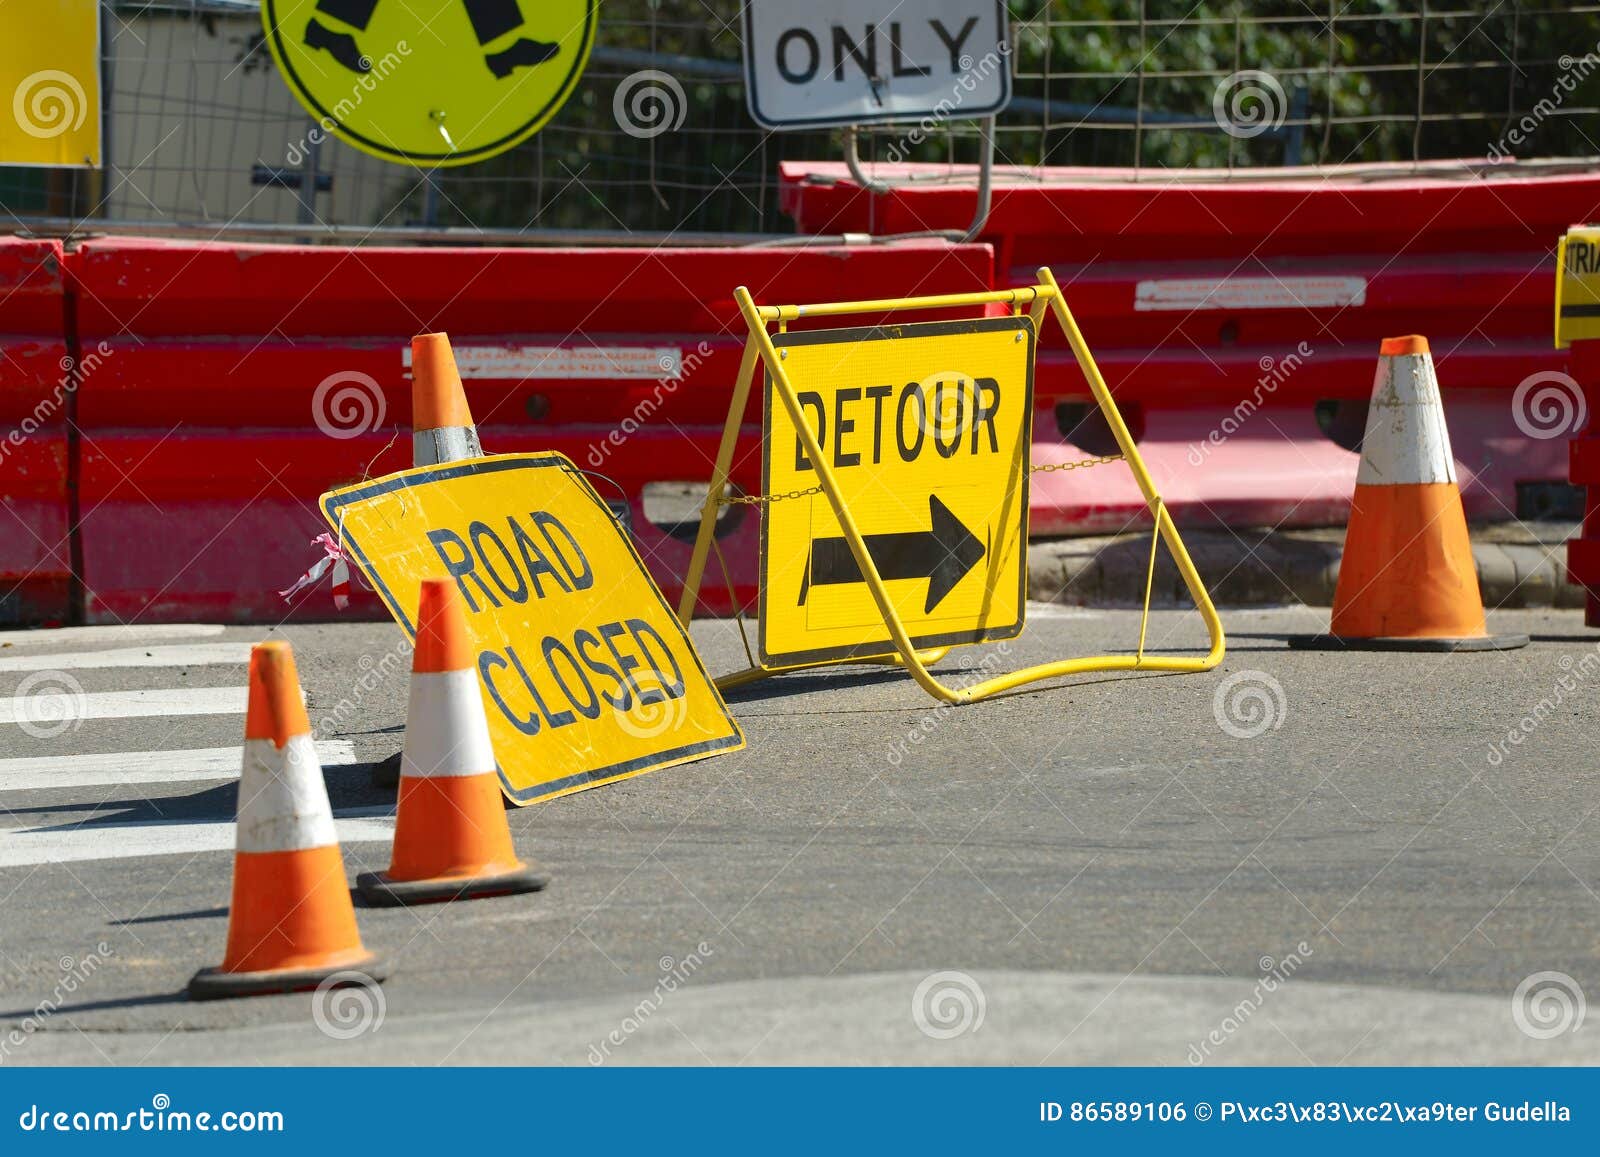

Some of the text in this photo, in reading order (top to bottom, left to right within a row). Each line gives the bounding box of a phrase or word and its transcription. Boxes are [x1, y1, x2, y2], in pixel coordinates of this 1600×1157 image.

[776, 16, 979, 84] ONLY
[1564, 242, 1600, 273] TRI
[795, 377, 1000, 471] DETOUR
[426, 511, 593, 613] ROAD
[478, 619, 685, 735] CLOSED
